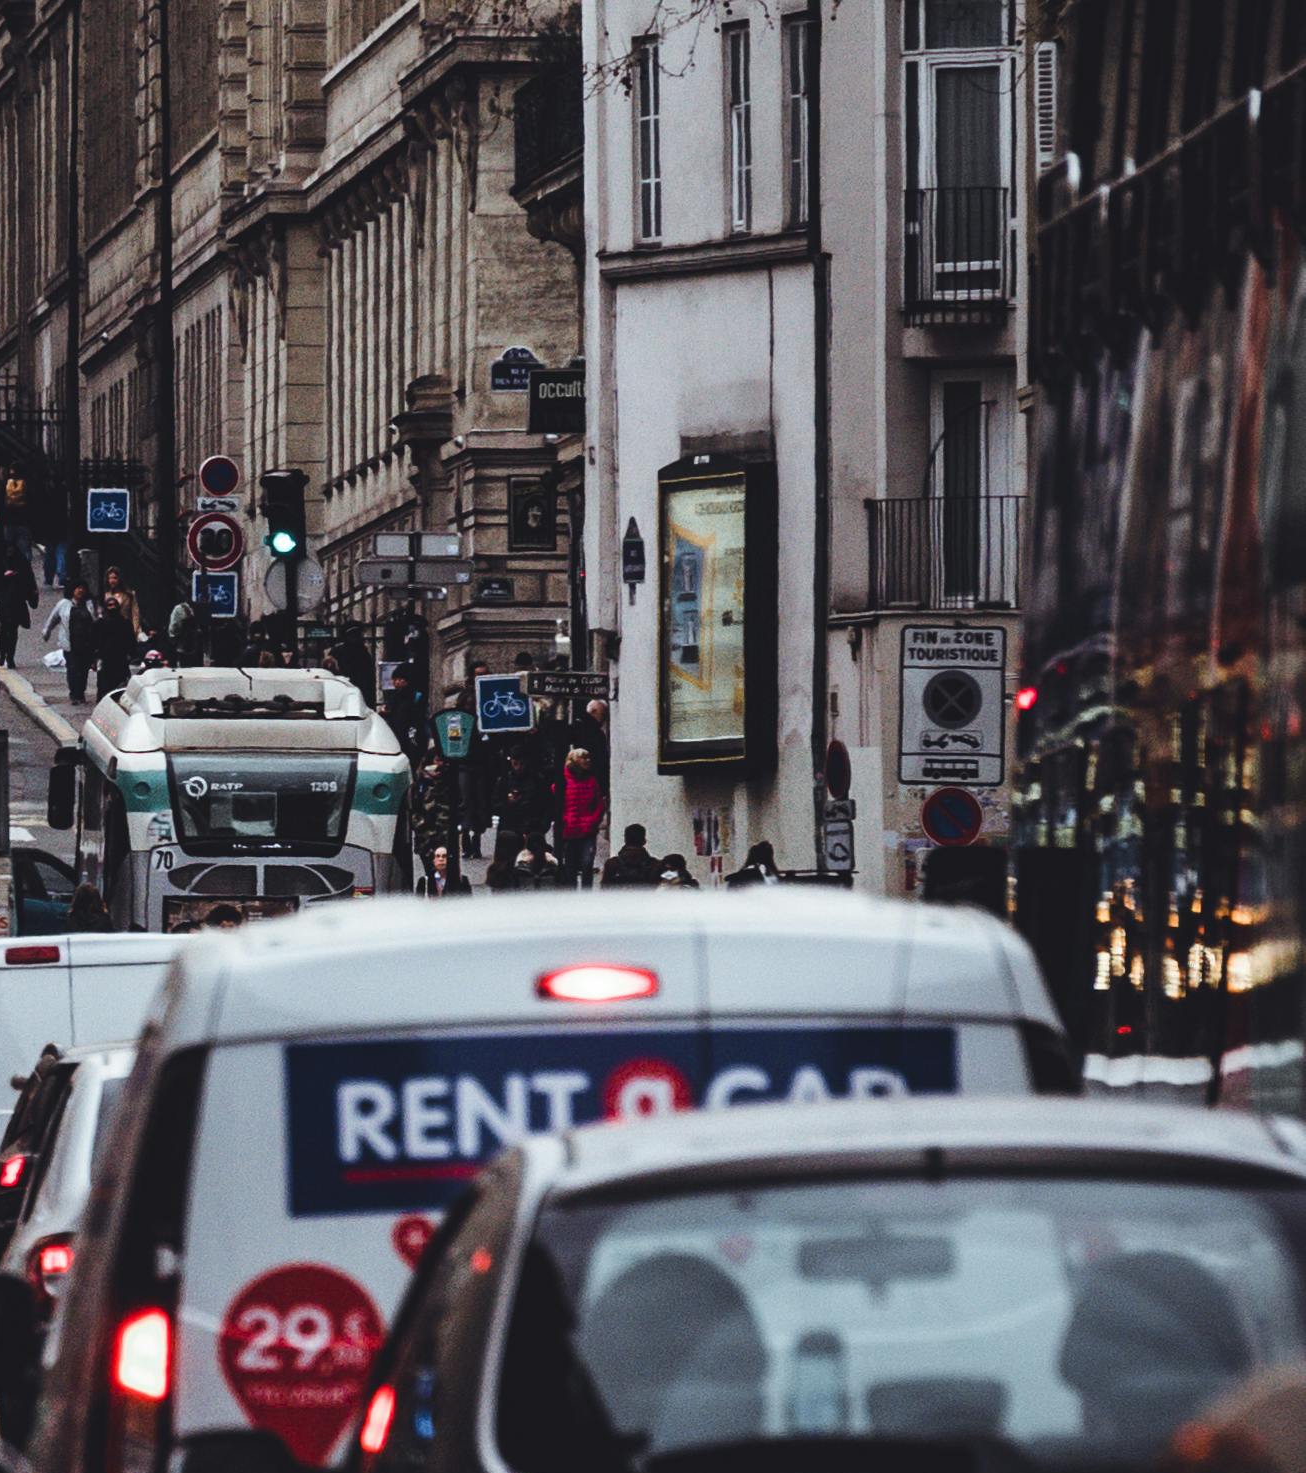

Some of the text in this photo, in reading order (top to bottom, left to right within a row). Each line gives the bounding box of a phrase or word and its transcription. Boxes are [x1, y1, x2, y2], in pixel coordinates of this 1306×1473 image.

[912, 631, 939, 644] FIN
[953, 632, 995, 646] ZONE
[907, 647, 999, 662] TOURISTIQUE
[210, 782, 244, 791] RATP
[156, 851, 173, 869] 70
[337, 1073, 589, 1163] RENT
